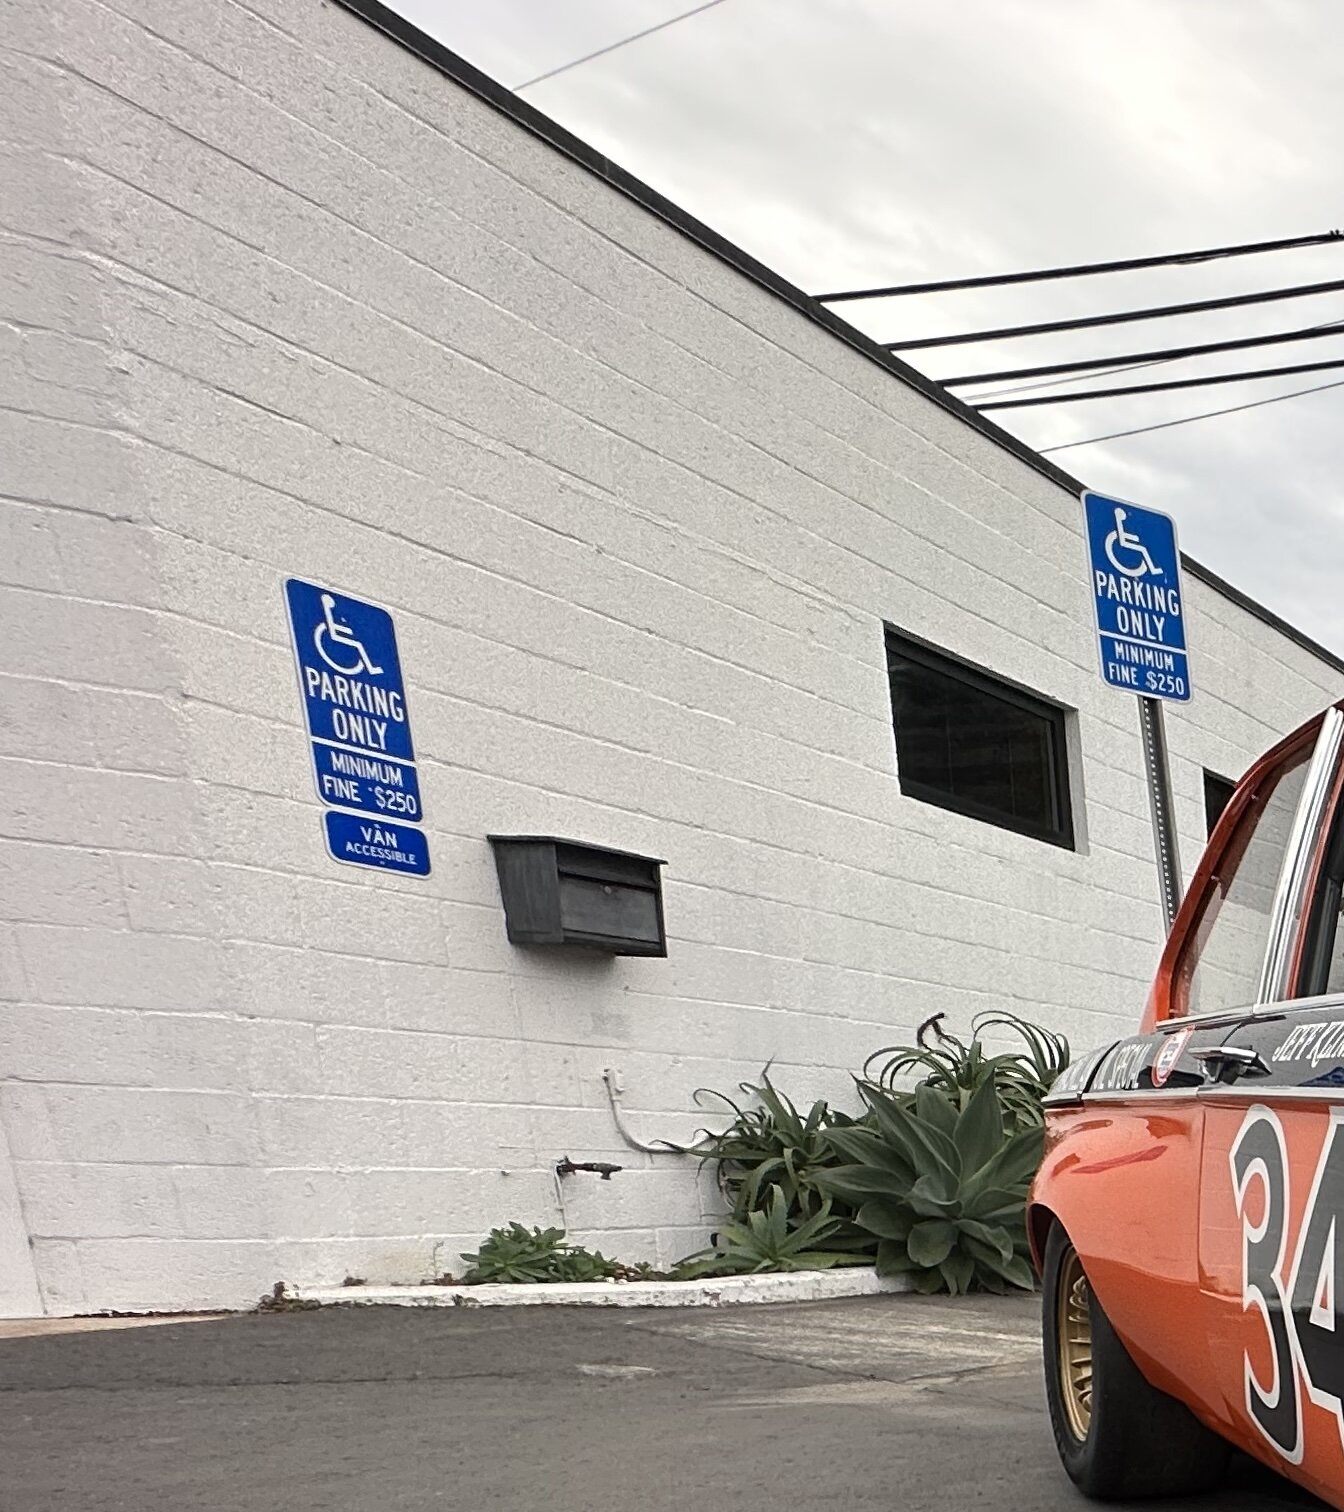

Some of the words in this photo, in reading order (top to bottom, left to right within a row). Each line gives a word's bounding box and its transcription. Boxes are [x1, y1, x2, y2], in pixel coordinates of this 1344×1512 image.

[1095, 569, 1179, 616] PARKING
[1116, 605, 1165, 642] ONLY
[1114, 640, 1174, 671] MINIMUM
[305, 665, 405, 722] PARKING
[1108, 661, 1139, 685] FINE
[1146, 670, 1185, 695] $250
[332, 708, 388, 751] ONLY
[330, 750, 403, 788] MINIMUM
[322, 774, 362, 803] FINE
[374, 785, 418, 815] $250
[345, 841, 418, 866] ACCESSIBLE
[360, 826, 398, 849] VAN
